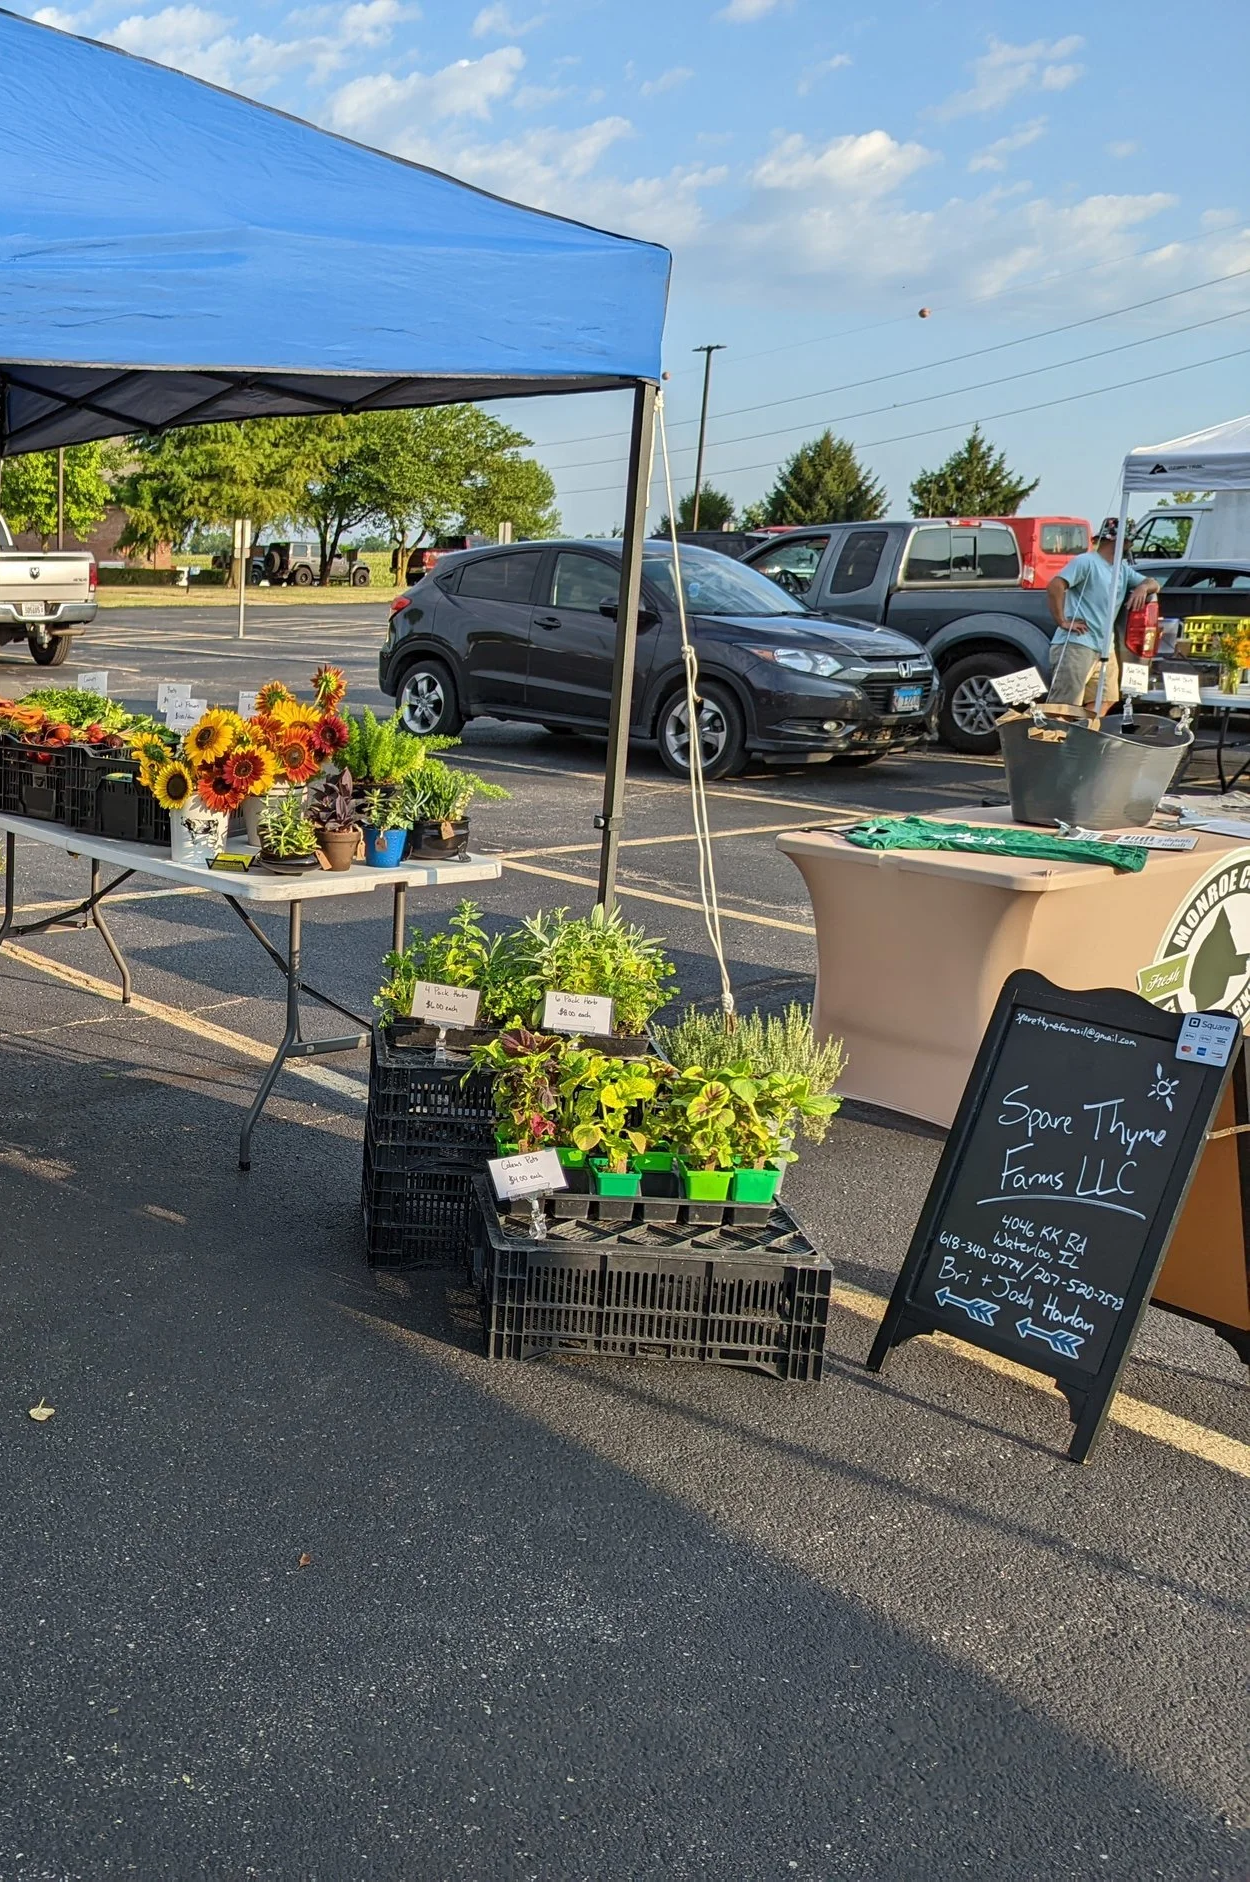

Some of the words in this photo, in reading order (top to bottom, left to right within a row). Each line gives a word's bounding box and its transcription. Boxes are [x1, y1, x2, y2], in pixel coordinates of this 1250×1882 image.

[1172, 868, 1239, 949] MONROE
[424, 985, 430, 994] 4
[434, 987, 449, 996] Pack
[1146, 967, 1180, 993] Fresh
[563, 995, 580, 1004] Pack
[1201, 1020, 1231, 1032] Square
[998, 1085, 1073, 1138] Spare
[1083, 1098, 1167, 1156] Thyme
[524, 1155, 539, 1164] Pots
[1000, 1142, 1064, 1190] Farms
[1075, 1155, 1138, 1196] LLC
[508, 1174, 528, 1185] $4.00
[529, 1171, 544, 1180] each
[993, 1230, 1054, 1264] Waterloo,
[1058, 1250, 1080, 1270] IL
[1001, 1214, 1035, 1238] 4046
[1039, 1225, 1064, 1245] KK
[1065, 1232, 1088, 1256] Rd
[937, 1255, 973, 1284] Bri
[980, 1273, 993, 1287] +
[991, 1274, 1035, 1310] Josh
[1042, 1292, 1094, 1336] Harlan
